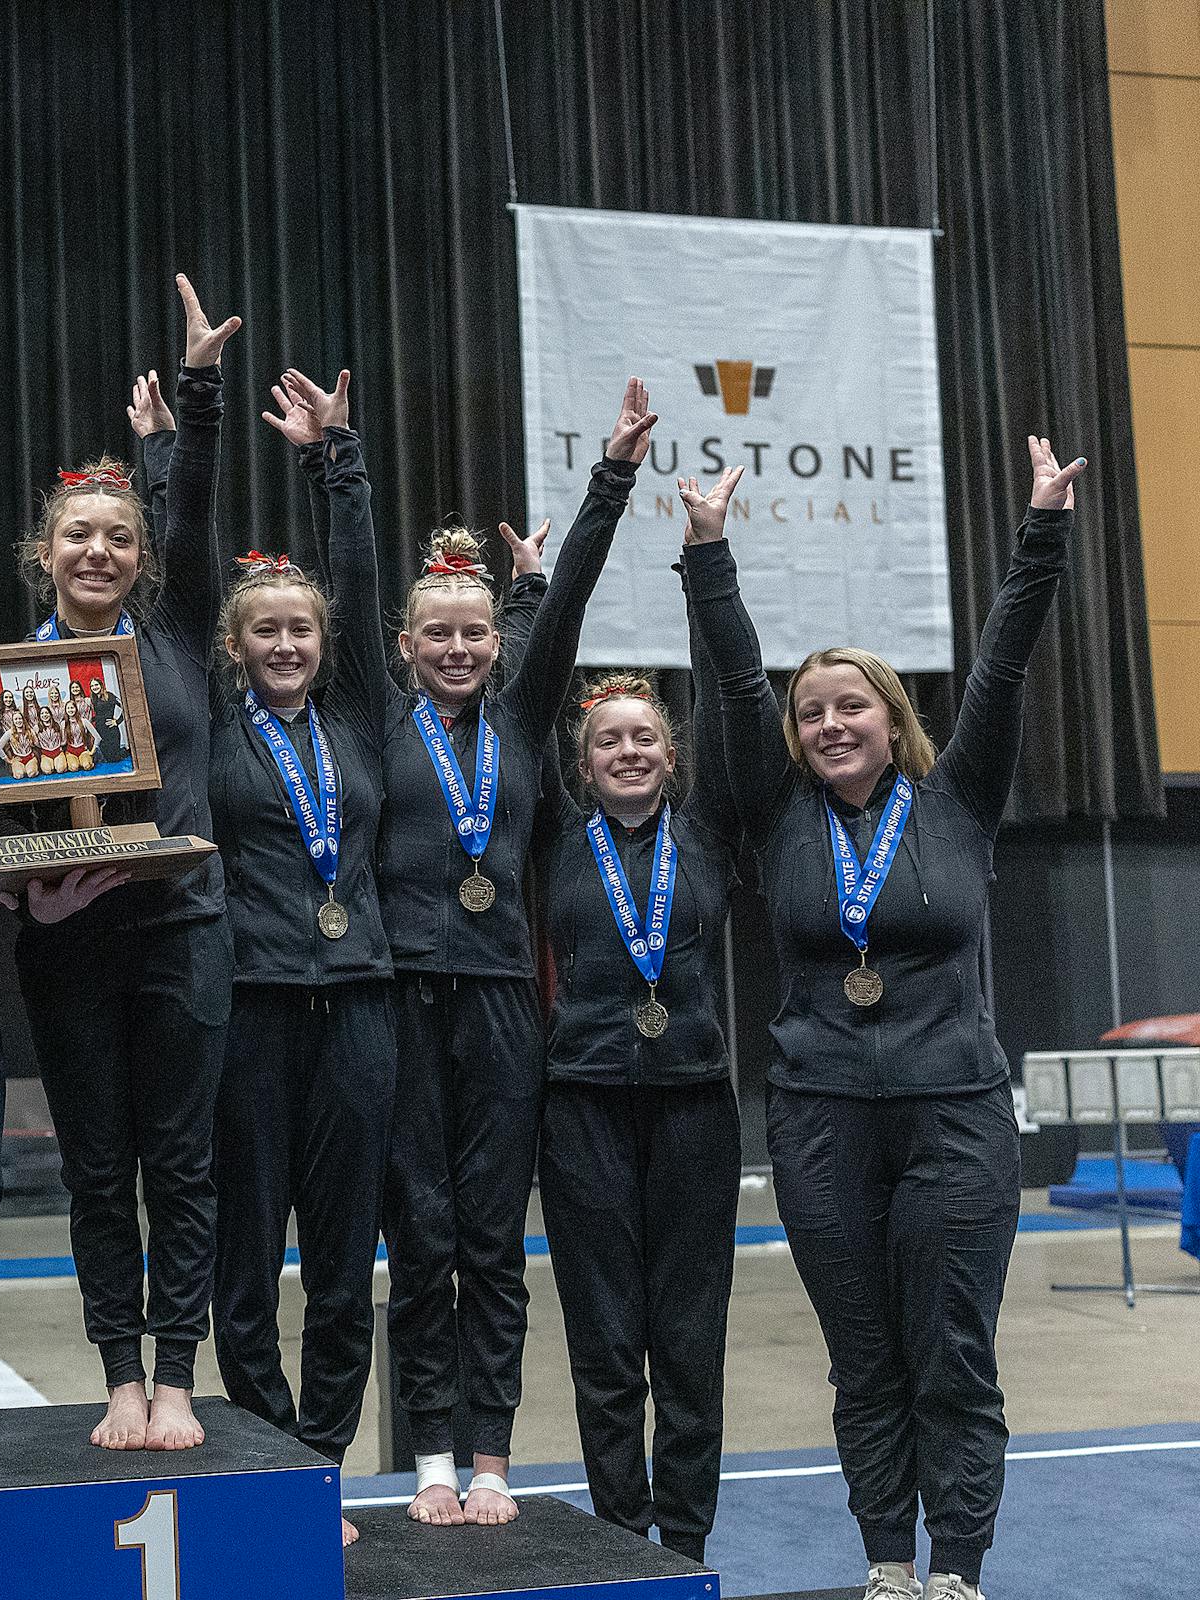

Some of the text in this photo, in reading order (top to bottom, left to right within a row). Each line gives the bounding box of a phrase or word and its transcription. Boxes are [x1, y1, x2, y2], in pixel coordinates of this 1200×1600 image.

[556, 430, 916, 483] TUSTONE
[628, 494, 884, 526] INNCIAL
[15, 671, 60, 692] Lakers
[262, 721, 319, 838] STATE CHAMPIONSHIPS
[313, 720, 337, 834] STATE CHAMPIONSHIPS
[419, 709, 467, 817] STATE CHAMPIONSHIPS
[478, 724, 493, 811] STATE CHAMPION
[2, 852, 51, 864] CLASS
[53, 850, 65, 860] A
[66, 842, 150, 859] CHAMPION
[4, 828, 113, 853] GYMNASTICS
[856, 799, 905, 904] STATE CHAMPIONSHIPS
[592, 826, 638, 938] STATE CHAMPIONSHIPS
[651, 894, 666, 929] STATE
[843, 861, 855, 895] STATE
[114, 1489, 180, 1600] 1
